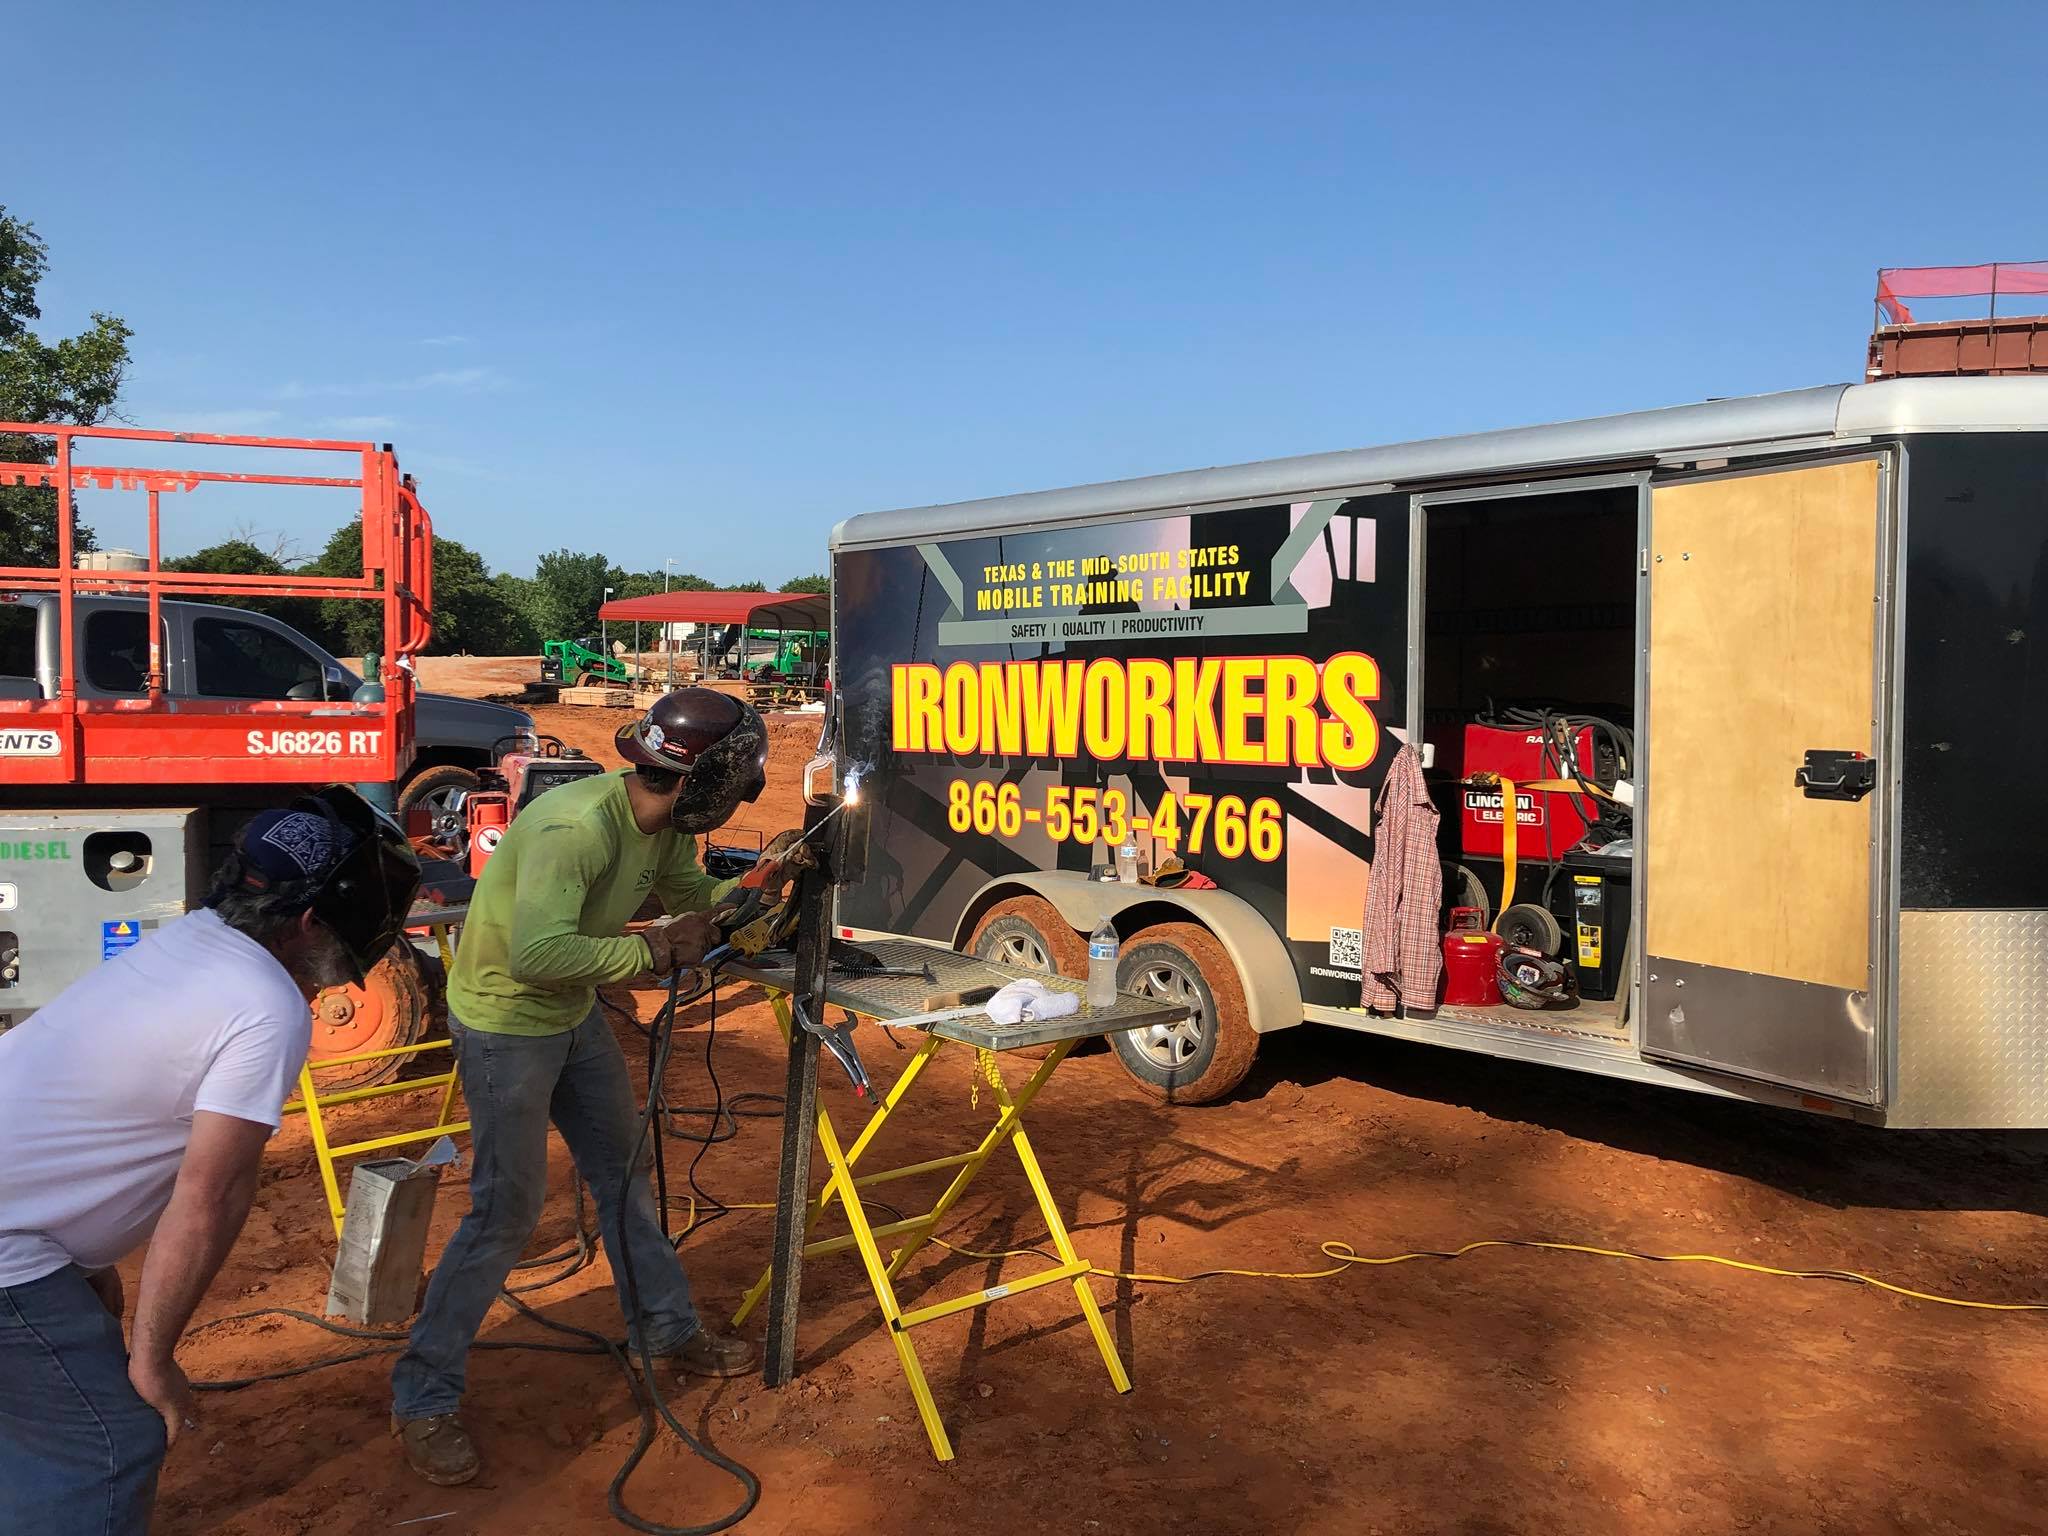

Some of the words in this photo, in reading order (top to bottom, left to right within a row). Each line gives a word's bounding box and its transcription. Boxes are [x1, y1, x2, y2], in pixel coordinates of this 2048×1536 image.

[984, 563, 1026, 583] TEXAS
[1032, 562, 1042, 580] &
[1047, 559, 1075, 578] THE
[1081, 552, 1170, 576] MID-SOUTH
[1178, 544, 1239, 568] STATES
[977, 585, 1043, 611] MOBILE
[1050, 579, 1143, 606] TRAINING
[1153, 571, 1250, 600] FACILITY
[1011, 623, 1047, 638] SAFETY
[1062, 620, 1106, 637] QUALITY
[1121, 615, 1204, 634] PRODUCTIVITY
[891, 651, 1380, 770] IRONWORKERS
[247, 730, 342, 754] SJ6826
[349, 731, 382, 754] RT
[1468, 795, 1529, 809] LINCN
[947, 779, 1283, 862] 866-553-4766
[1482, 810, 1537, 822] ELERIC
[0, 840, 72, 861] DIESEL
